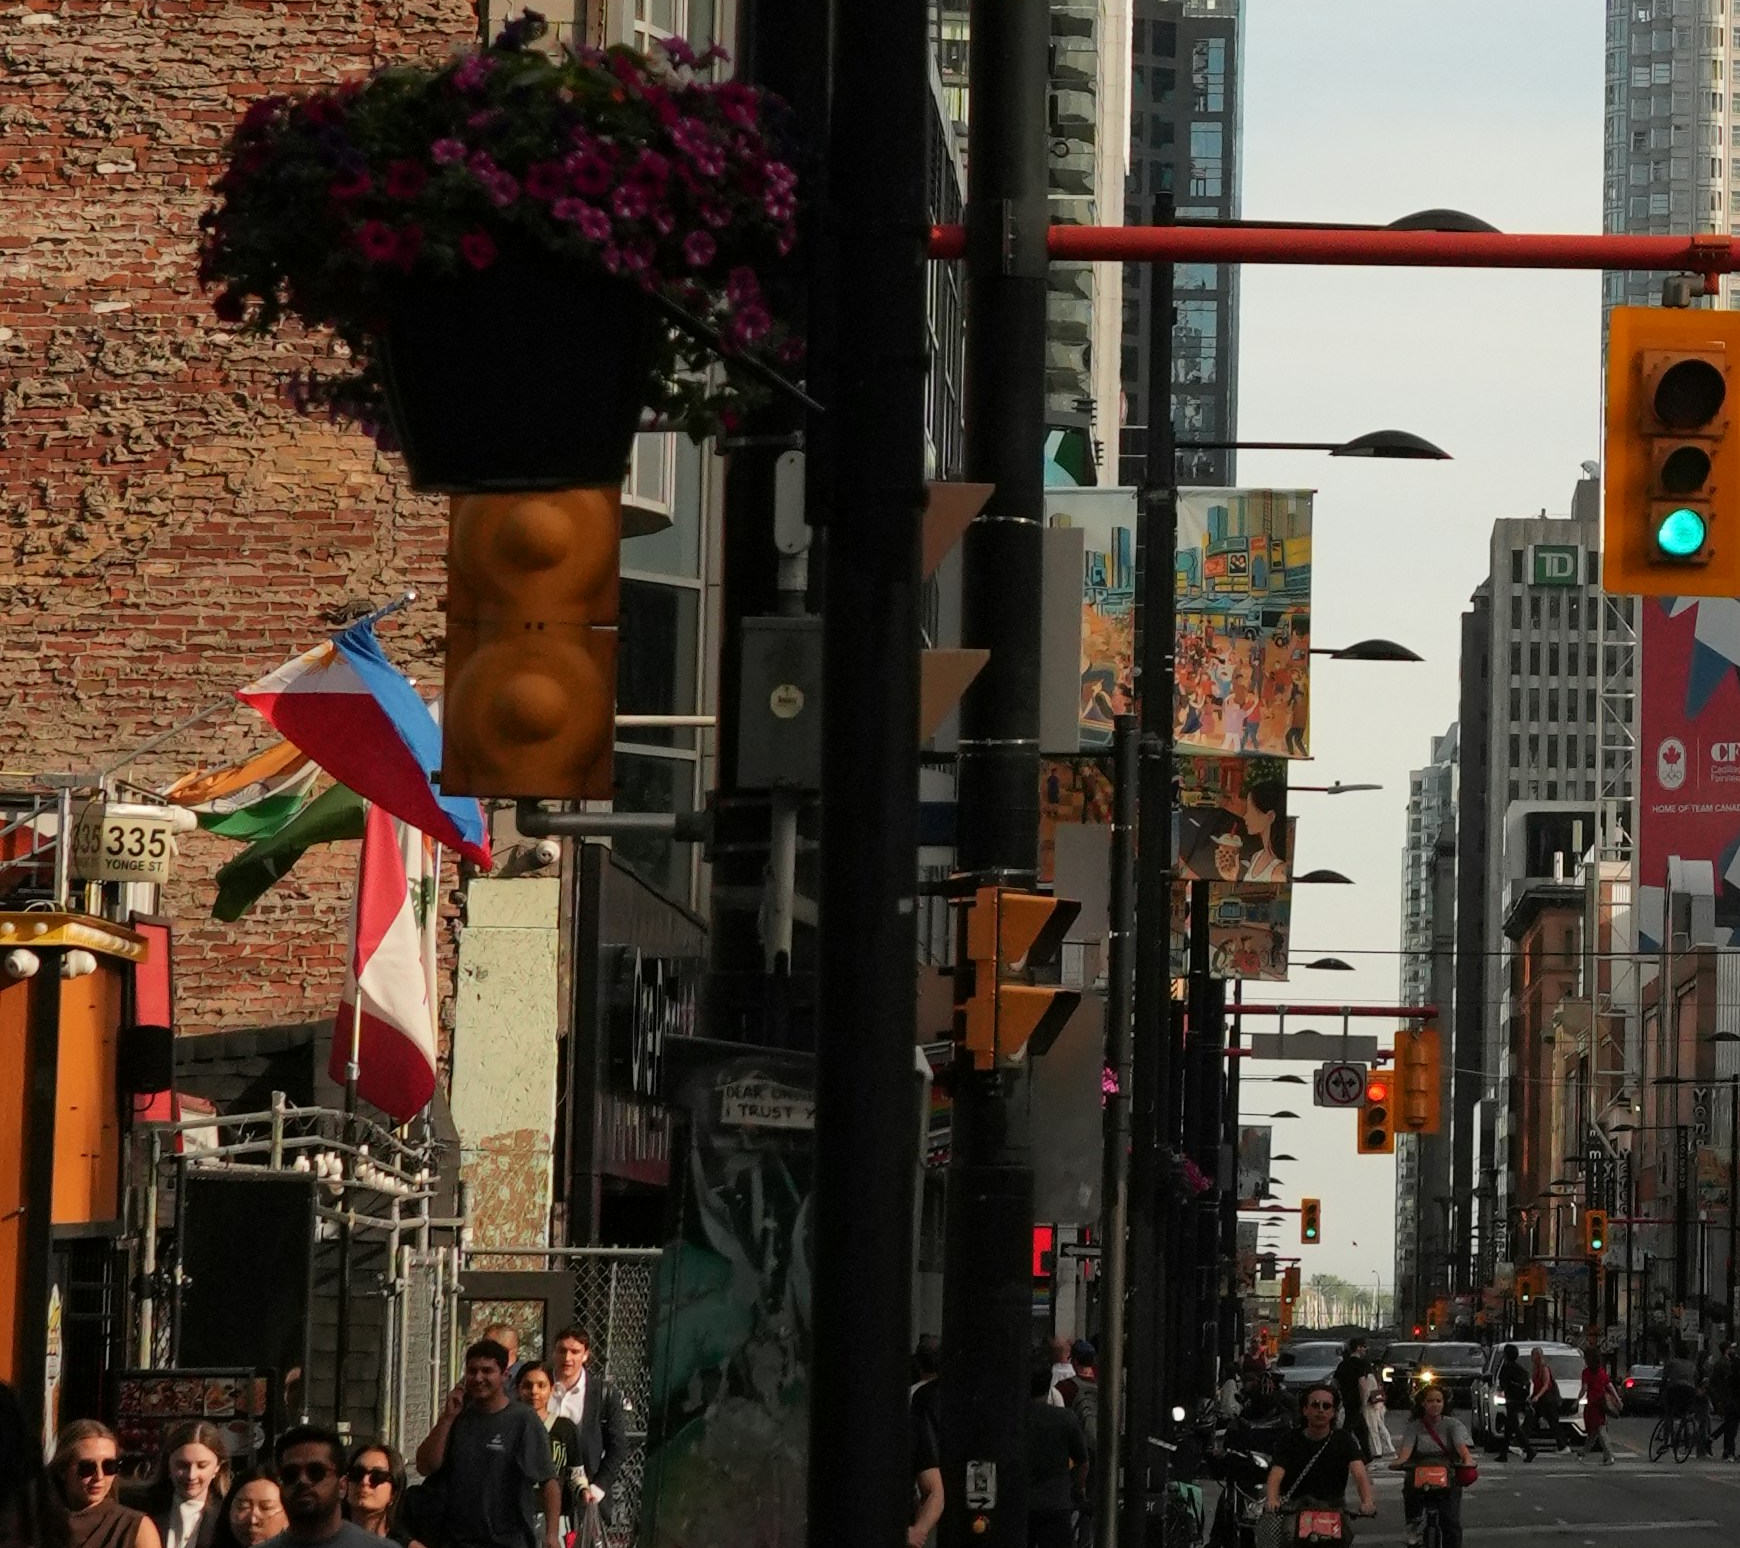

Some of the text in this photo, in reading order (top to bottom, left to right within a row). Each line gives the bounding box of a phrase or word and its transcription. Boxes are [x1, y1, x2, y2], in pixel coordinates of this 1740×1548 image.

[1538, 552, 1574, 577] TD
[1652, 804, 1677, 814] HOME
[1678, 804, 1690, 813] OF
[1691, 803, 1714, 813] TEAM
[106, 825, 166, 858] 335
[105, 858, 145, 872] YONGE
[148, 860, 164, 873] ST.
[737, 1103, 792, 1119] TRUST
